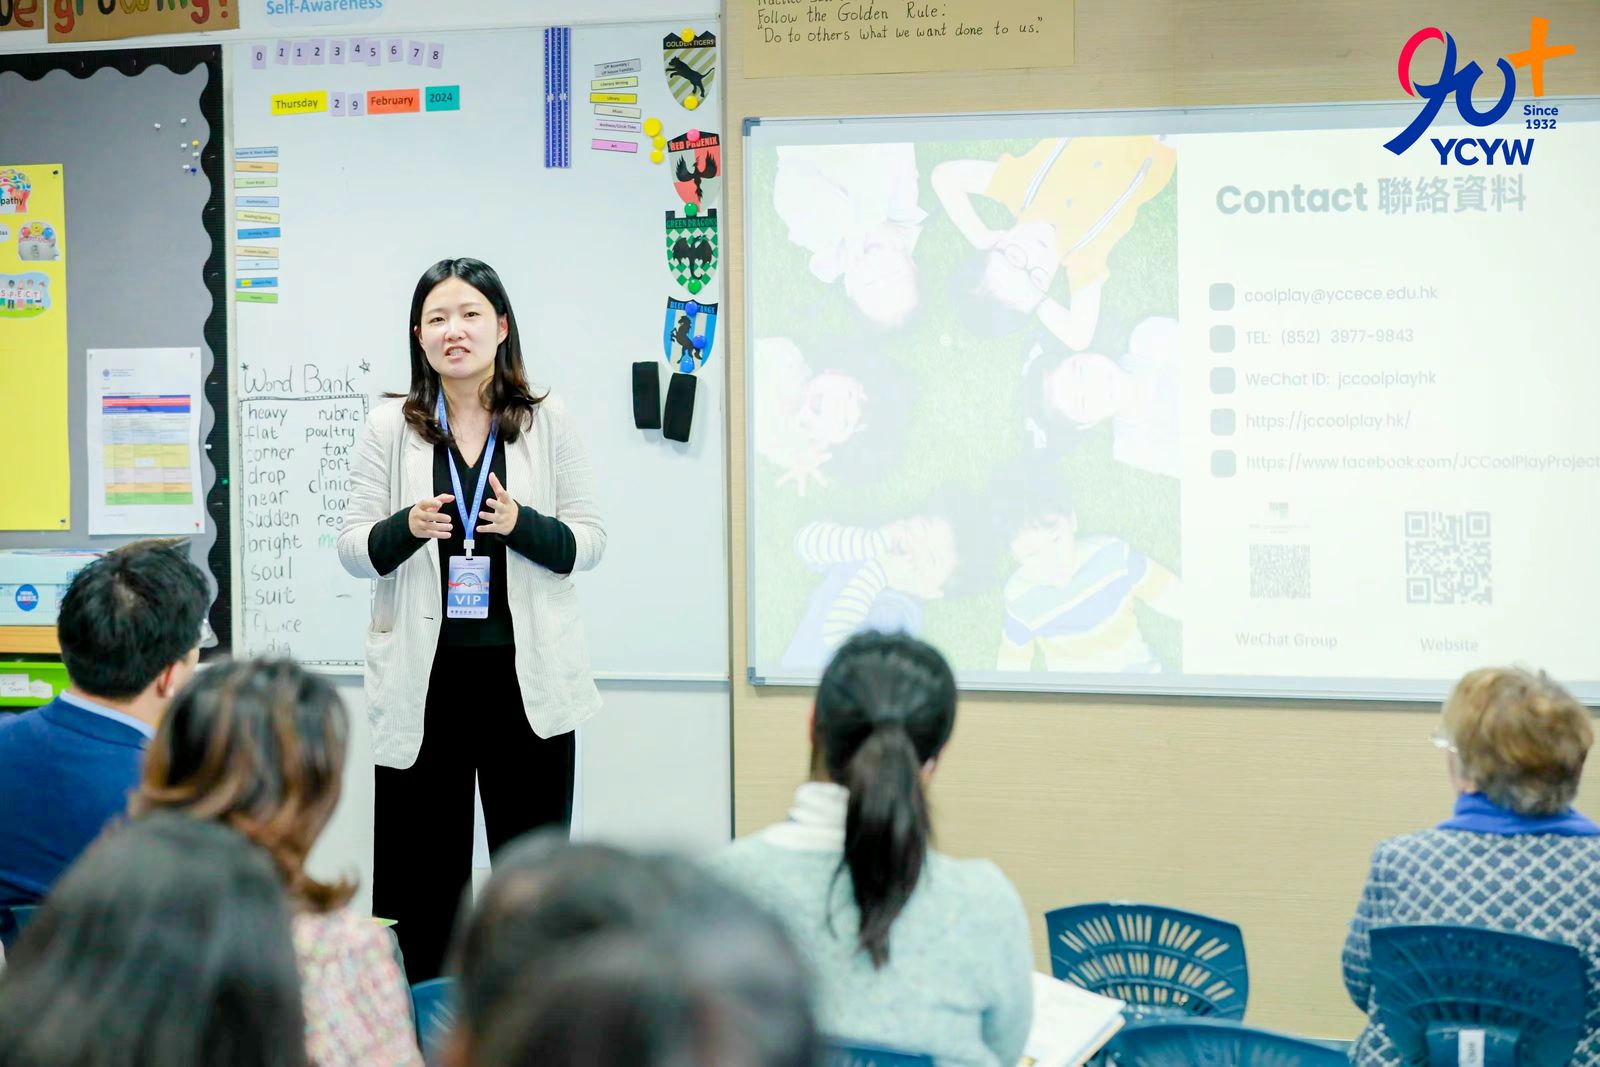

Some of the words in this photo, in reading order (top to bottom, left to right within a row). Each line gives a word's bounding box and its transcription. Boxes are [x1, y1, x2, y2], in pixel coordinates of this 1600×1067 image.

[266, 0, 383, 16] Self-Awareness
[757, 8, 797, 25] Follow
[806, 6, 827, 23] the
[838, 2, 889, 21] Golden
[906, 1, 946, 19] Rule:
[788, 27, 801, 42] to
[807, 26, 850, 42] others
[859, 25, 888, 40] what
[896, 27, 910, 38] we
[916, 22, 947, 37] want
[955, 22, 983, 36] done
[994, 20, 1009, 35] to
[275, 97, 319, 109] Thursday
[334, 98, 340, 108] 2
[352, 100, 358, 110] 9
[371, 95, 414, 107] February
[429, 92, 453, 103] 2024
[670, 141, 685, 151] RED
[1215, 182, 1368, 214] Contact
[1377, 173, 1526, 215] 聯絡資料
[666, 219, 686, 228] GREEN
[687, 217, 717, 227] DRAGONS
[1244, 285, 1438, 306] coolplay@yccece.edu.hk
[1246, 331, 1271, 345] TEL:
[1281, 328, 1321, 346] (852)
[1330, 328, 1414, 344] 3977-9843
[244, 365, 293, 394] Word
[303, 363, 356, 394] Bank
[1245, 371, 1308, 387] WeChat
[1312, 371, 1330, 387] ID:
[1337, 370, 1437, 390] jccoolplayhk
[248, 403, 288, 427] heavy
[318, 403, 360, 422] rubric
[1246, 410, 1411, 431] https://jccoolplay.hk/
[245, 424, 280, 443] flat
[305, 424, 355, 448] poultry
[322, 442, 350, 457] tax
[248, 464, 286, 486] drop
[248, 489, 289, 508] near
[246, 509, 300, 529] sudden
[247, 531, 303, 560] bright
[250, 556, 292, 582] soul
[255, 586, 296, 605] suit
[455, 594, 482, 605] VIP
[1235, 632, 1289, 647] WeChat
[1294, 633, 1338, 649] Group
[1420, 637, 1479, 652] Website
